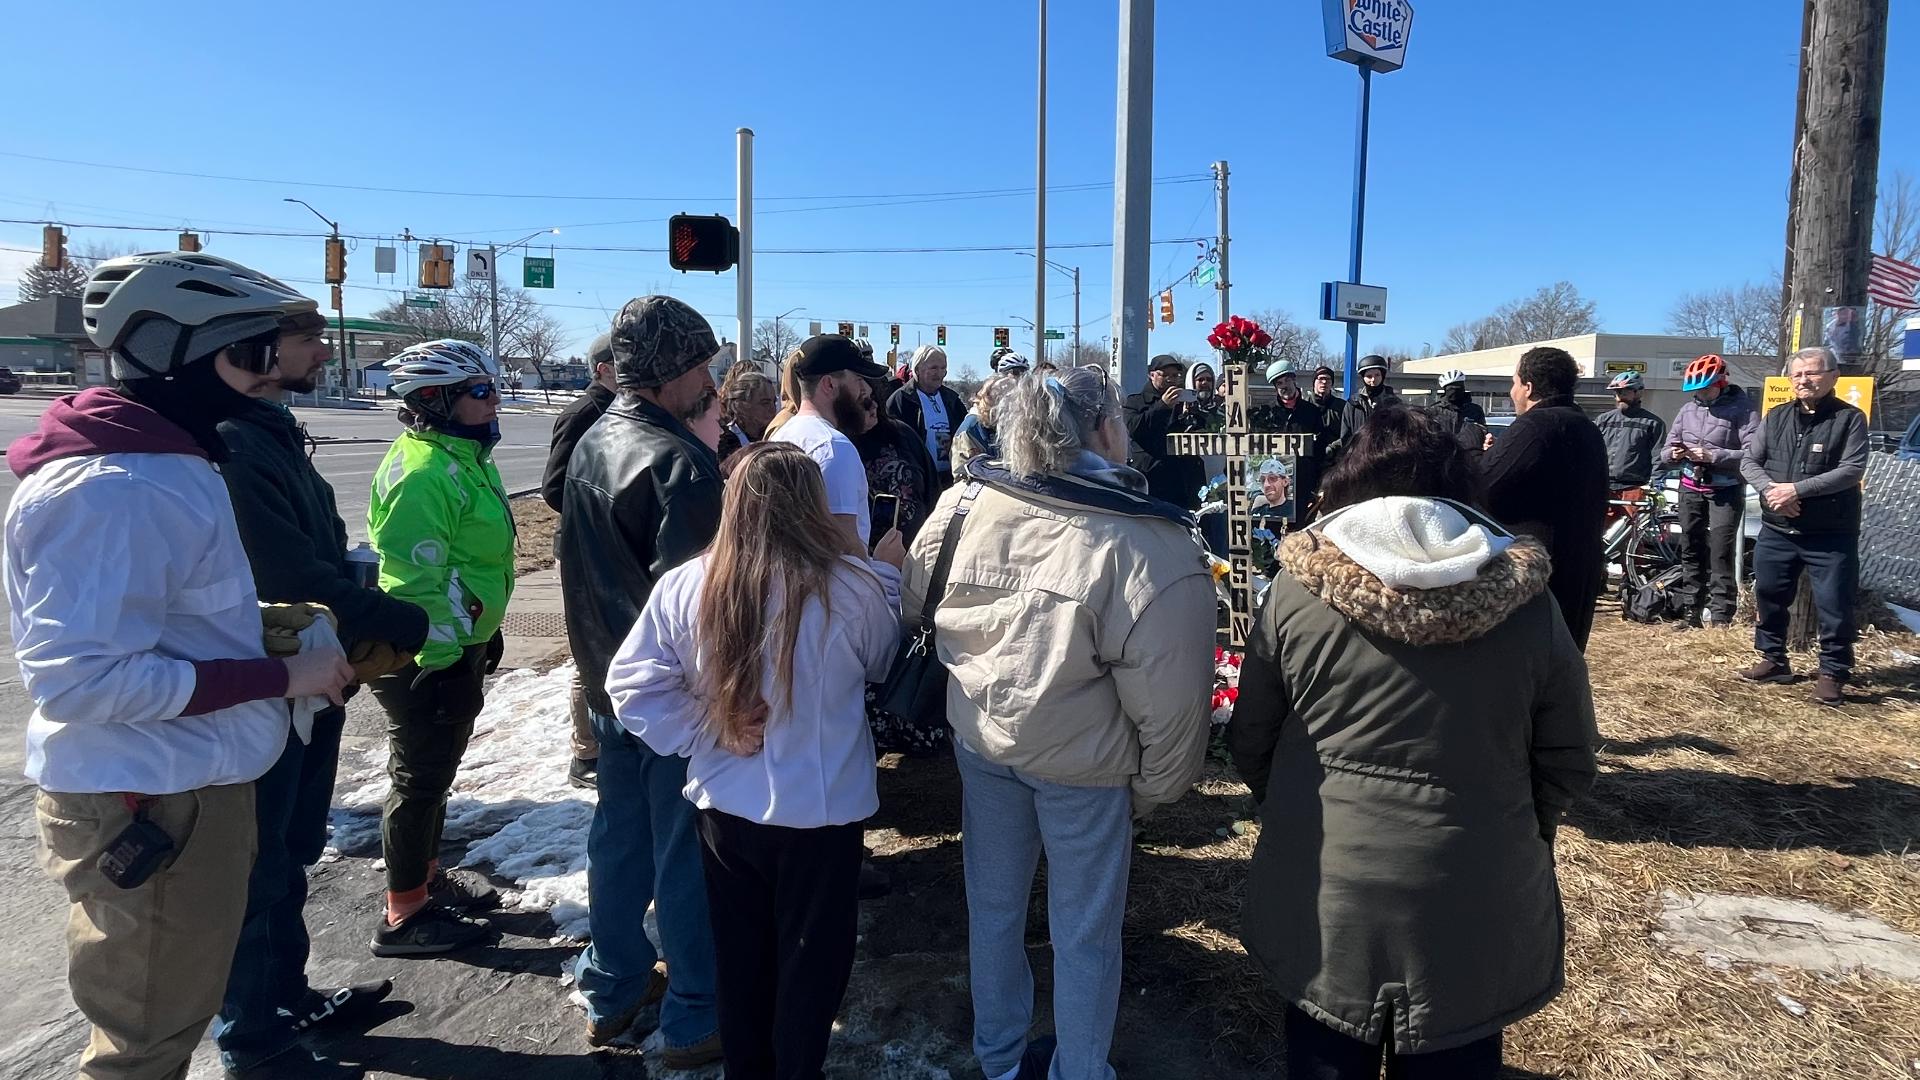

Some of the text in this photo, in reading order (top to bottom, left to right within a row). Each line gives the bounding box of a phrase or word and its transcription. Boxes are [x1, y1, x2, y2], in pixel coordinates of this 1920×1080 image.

[1350, 10, 1401, 44] Castle
[1177, 434, 1301, 456] BROTHER
[1232, 558, 1249, 644] SON
